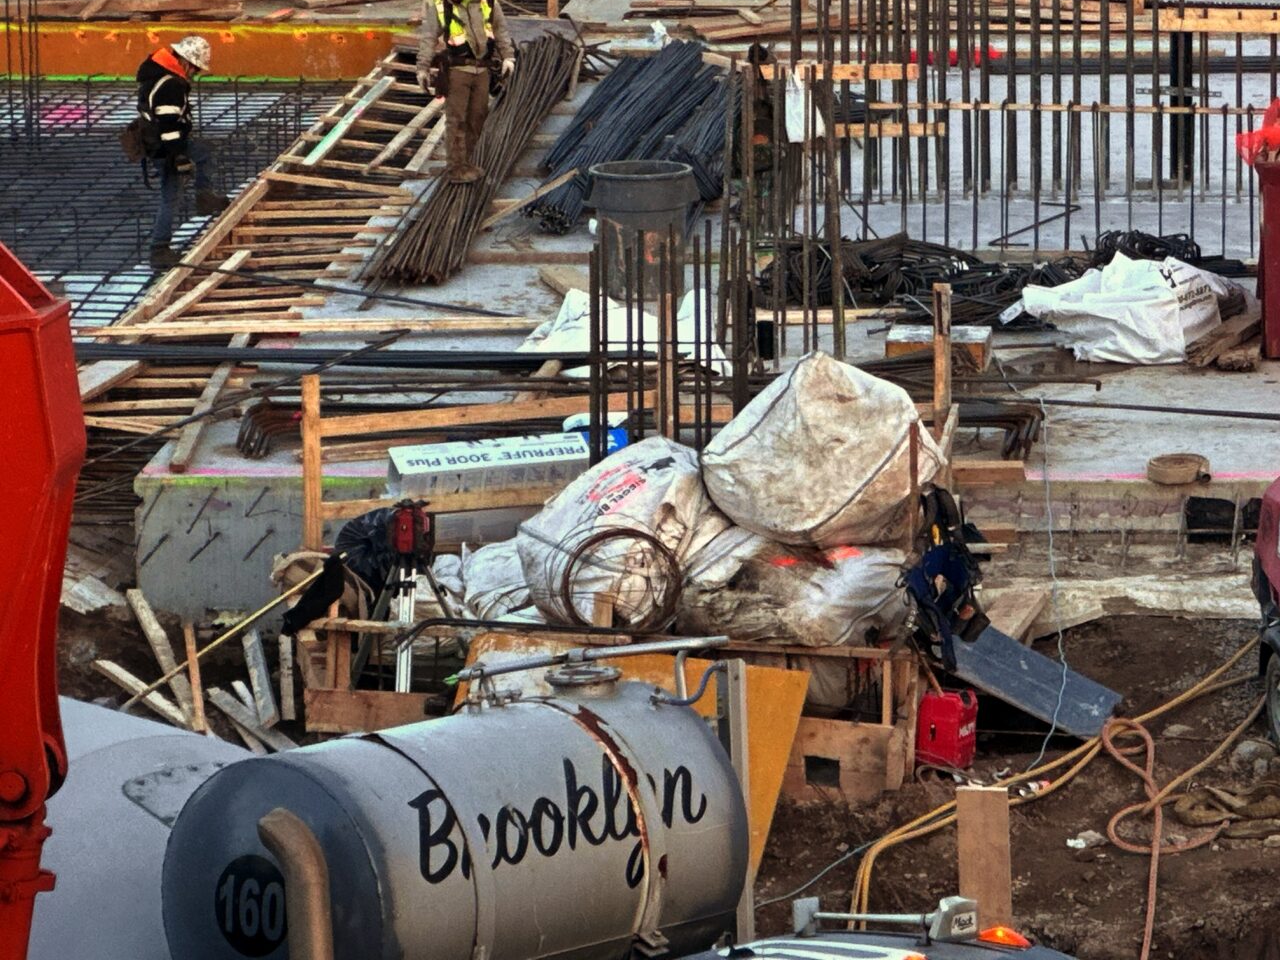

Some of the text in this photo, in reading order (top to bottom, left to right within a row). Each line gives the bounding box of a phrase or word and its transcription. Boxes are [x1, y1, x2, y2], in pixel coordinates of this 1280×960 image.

[406, 445, 586, 468] PREPRUFE 300R Plus
[220, 874, 285, 941] 160
